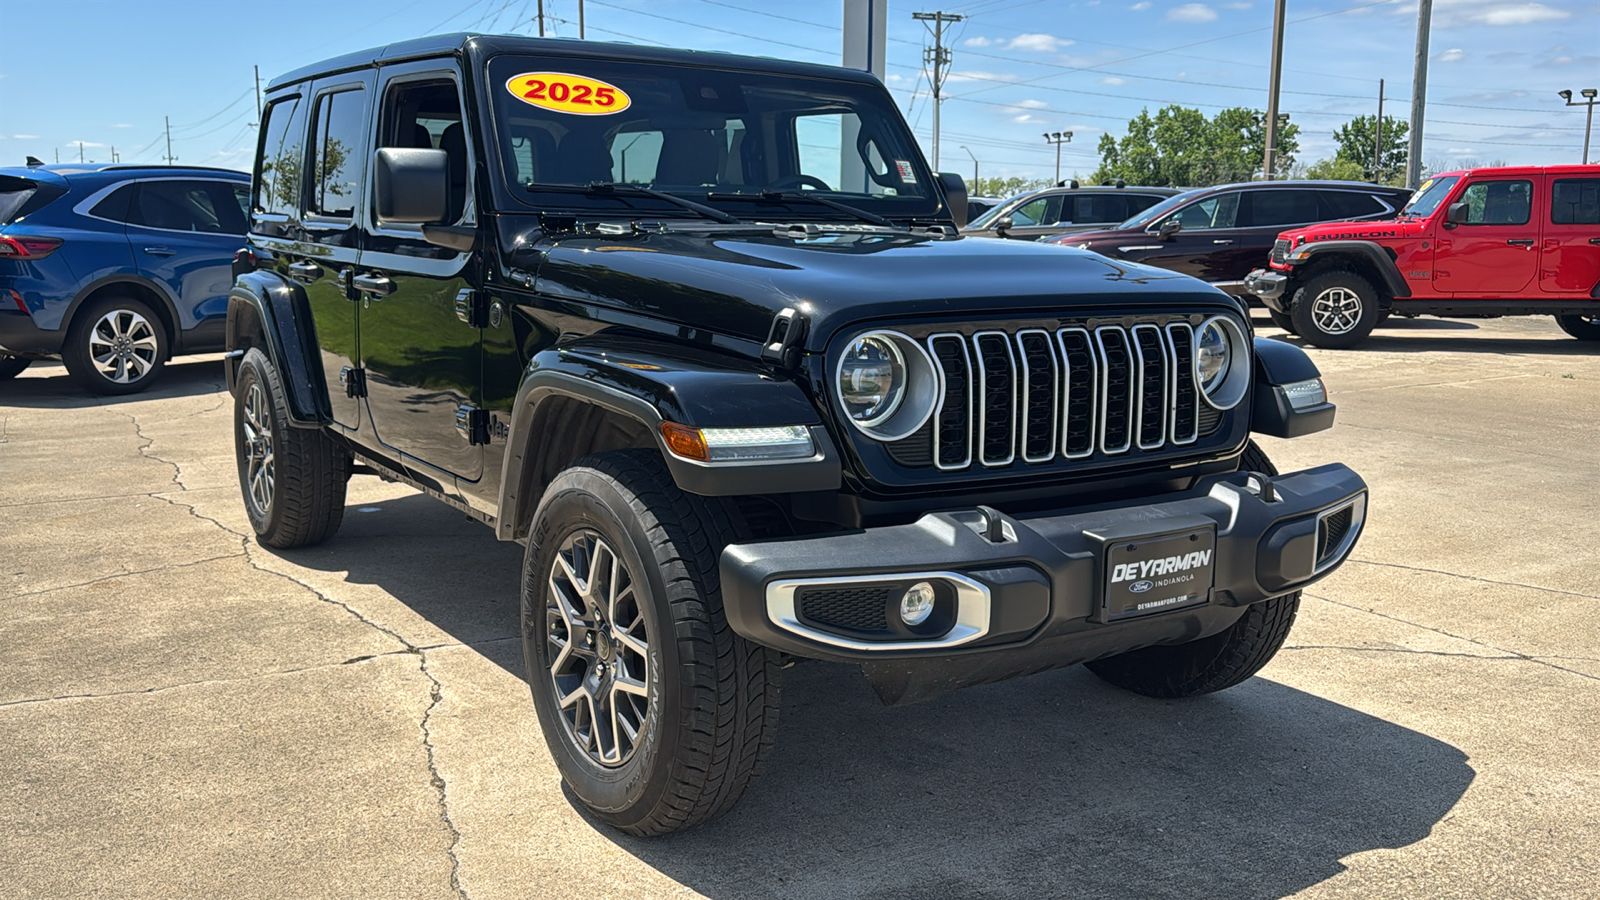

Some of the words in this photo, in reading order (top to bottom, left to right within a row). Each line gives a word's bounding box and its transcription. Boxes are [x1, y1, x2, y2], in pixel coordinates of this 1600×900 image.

[524, 80, 616, 106] 2025
[1313, 231, 1396, 241] RUBICON
[1111, 549, 1212, 583] DEYARMAN
[1154, 573, 1195, 587] INDIANOLA
[1137, 594, 1188, 610] DEYARMANFORD.COM
